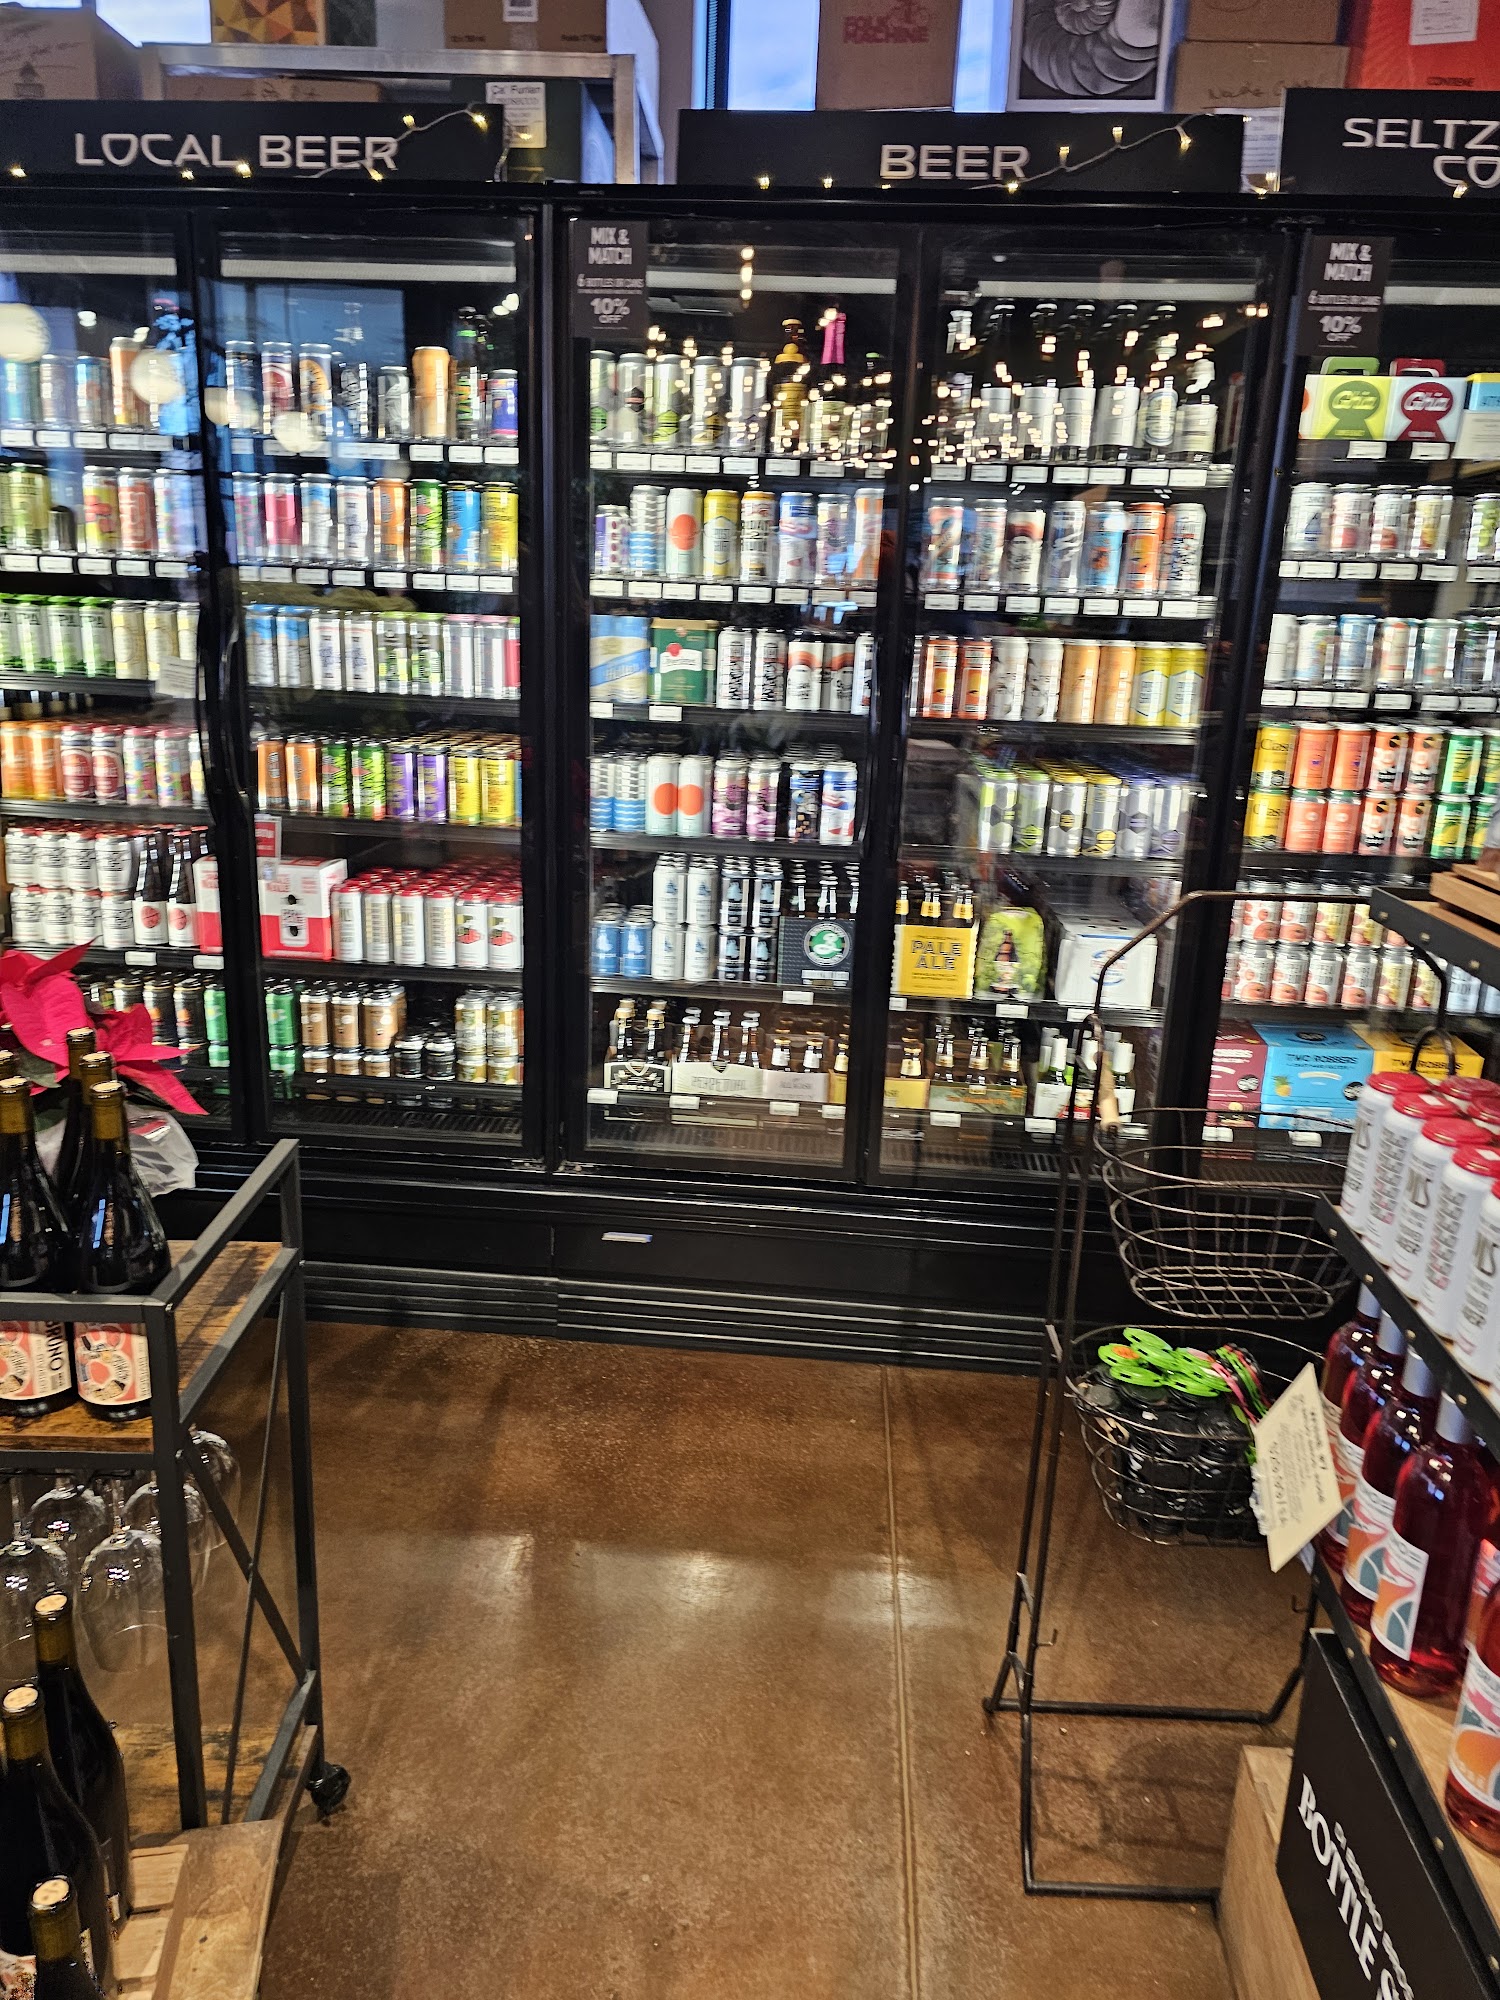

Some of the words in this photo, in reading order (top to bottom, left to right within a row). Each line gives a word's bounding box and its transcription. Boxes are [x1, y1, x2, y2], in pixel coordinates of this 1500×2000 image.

[843, 27, 930, 44] MACHINE
[1342, 118, 1500, 149] SELTZ
[75, 133, 239, 167] LOCAL
[258, 134, 398, 170] BEER
[880, 144, 1029, 181] BEER
[591, 227, 617, 245] MIX
[618, 228, 630, 246] &
[588, 247, 633, 265] MATCH
[1329, 242, 1359, 261] MIX
[1358, 244, 1372, 262] &
[1323, 262, 1373, 282] MATCH
[590, 298, 630, 315] 10%
[599, 315, 624, 324] OFF
[1319, 315, 1362, 333] 10%
[1326, 333, 1354, 342] OFF
[911, 940, 962, 956] PALE
[915, 955, 955, 970] ALE
[1297, 1773, 1378, 1982] BOTTLE
